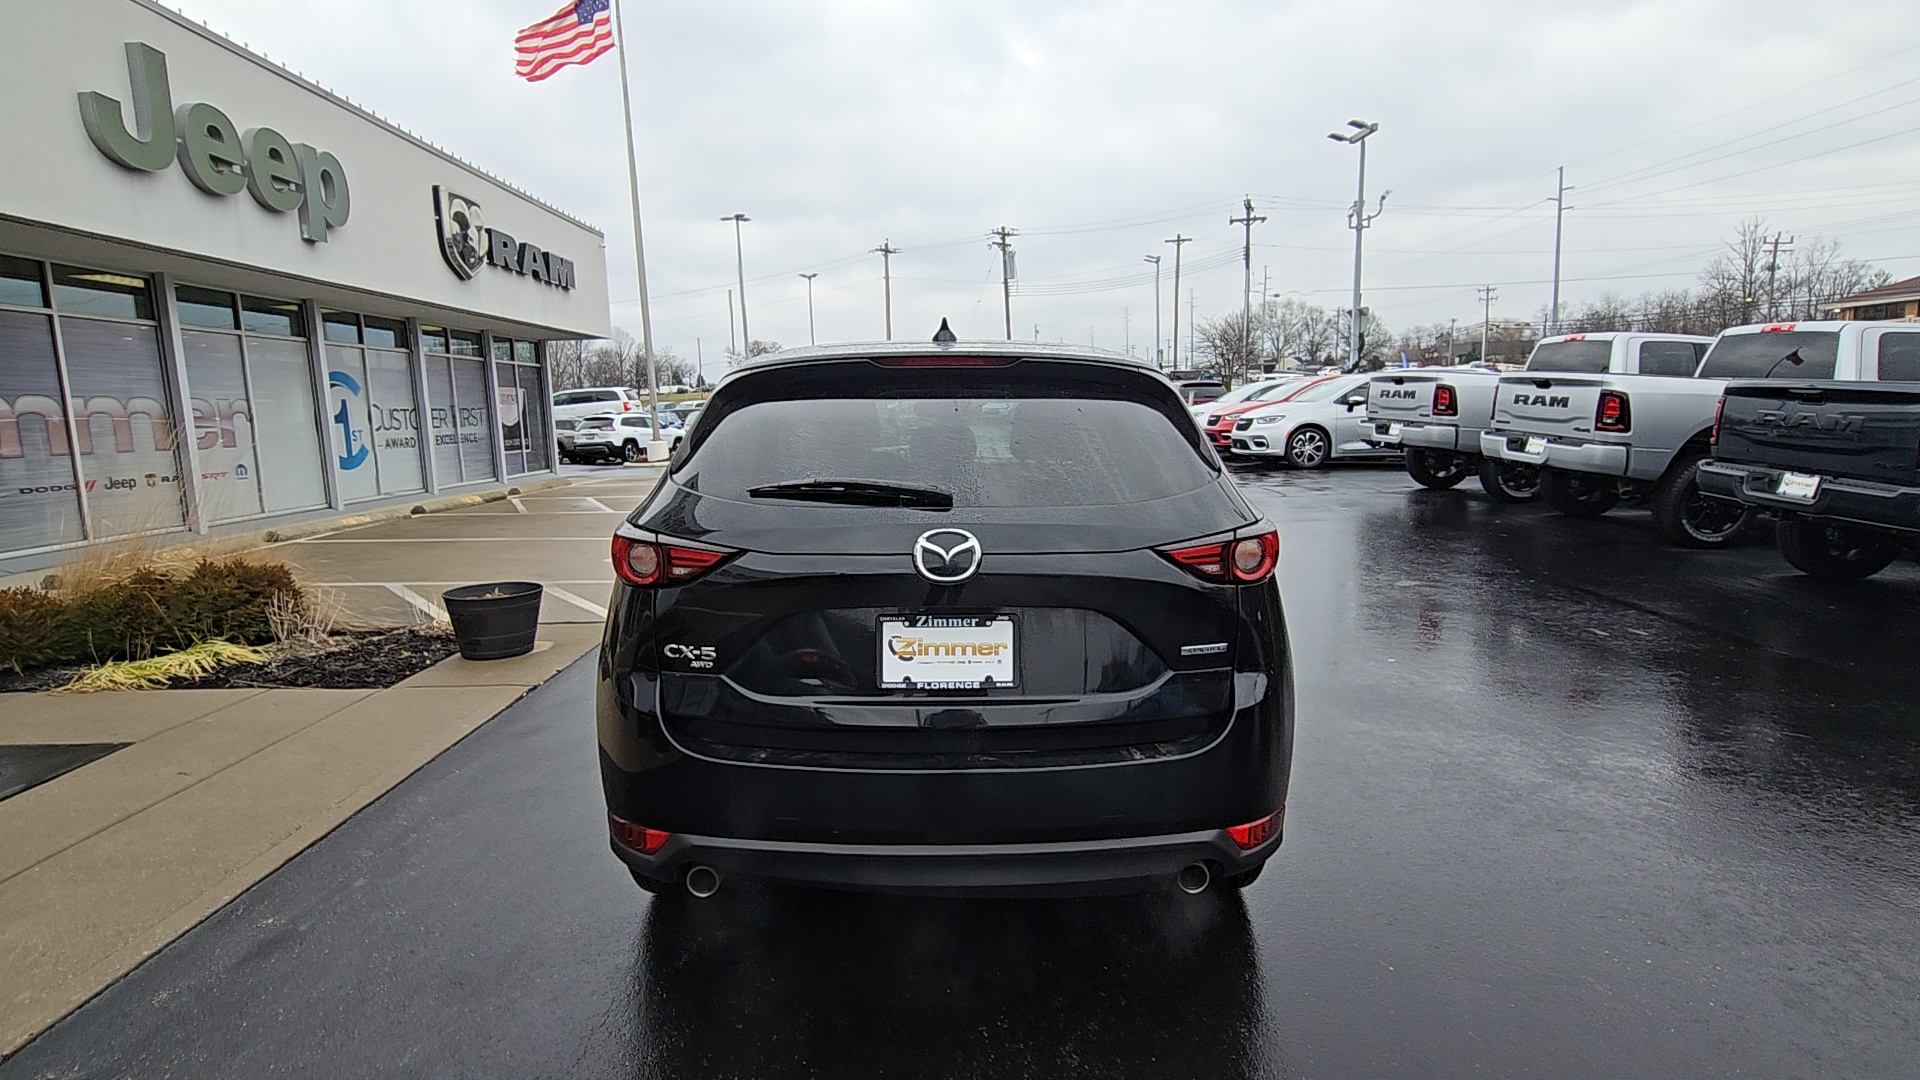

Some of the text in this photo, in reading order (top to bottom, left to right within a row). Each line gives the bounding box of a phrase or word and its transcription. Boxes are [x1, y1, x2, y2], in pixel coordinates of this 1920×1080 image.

[77, 41, 350, 243] Jeep
[485, 227, 577, 291] RAM
[1379, 389, 1417, 400] RAM
[1513, 393, 1570, 409] RAM
[1754, 409, 1865, 434] RAM
[385, 436, 417, 449] AWARD
[200, 472, 230, 480] SRT
[19, 484, 77, 495] DODG
[104, 476, 137, 490] Jeep
[915, 615, 979, 627] Zimmer
[663, 644, 717, 660] CX-5
[896, 637, 1008, 656] Zimmer
[690, 661, 714, 669] AWD
[916, 681, 980, 690] FLORENCE
